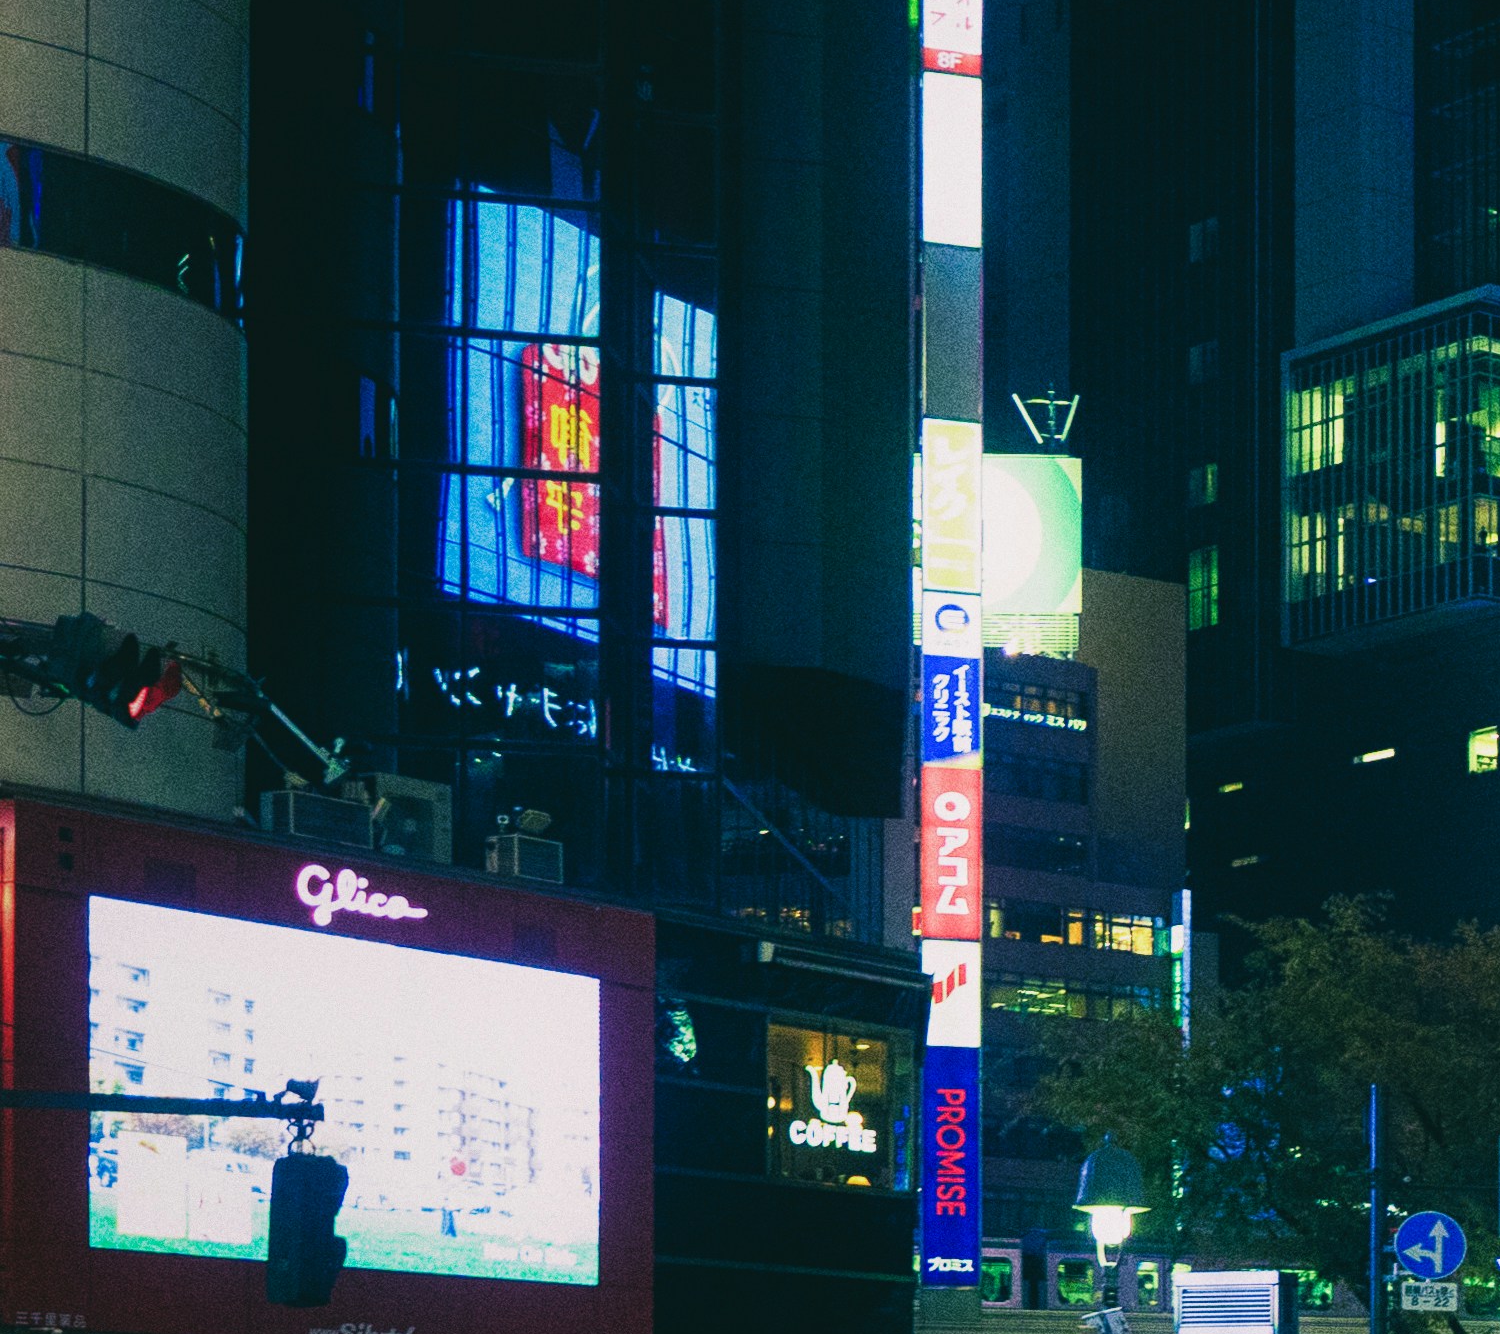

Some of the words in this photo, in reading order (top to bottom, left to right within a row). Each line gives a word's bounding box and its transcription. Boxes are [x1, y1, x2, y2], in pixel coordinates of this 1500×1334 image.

[296, 863, 429, 927] Glico
[936, 827, 970, 916] アコム
[789, 1120, 877, 1153] COFFEE
[936, 1088, 967, 1217] PROMISE
[927, 1258, 974, 1273] プロミス
